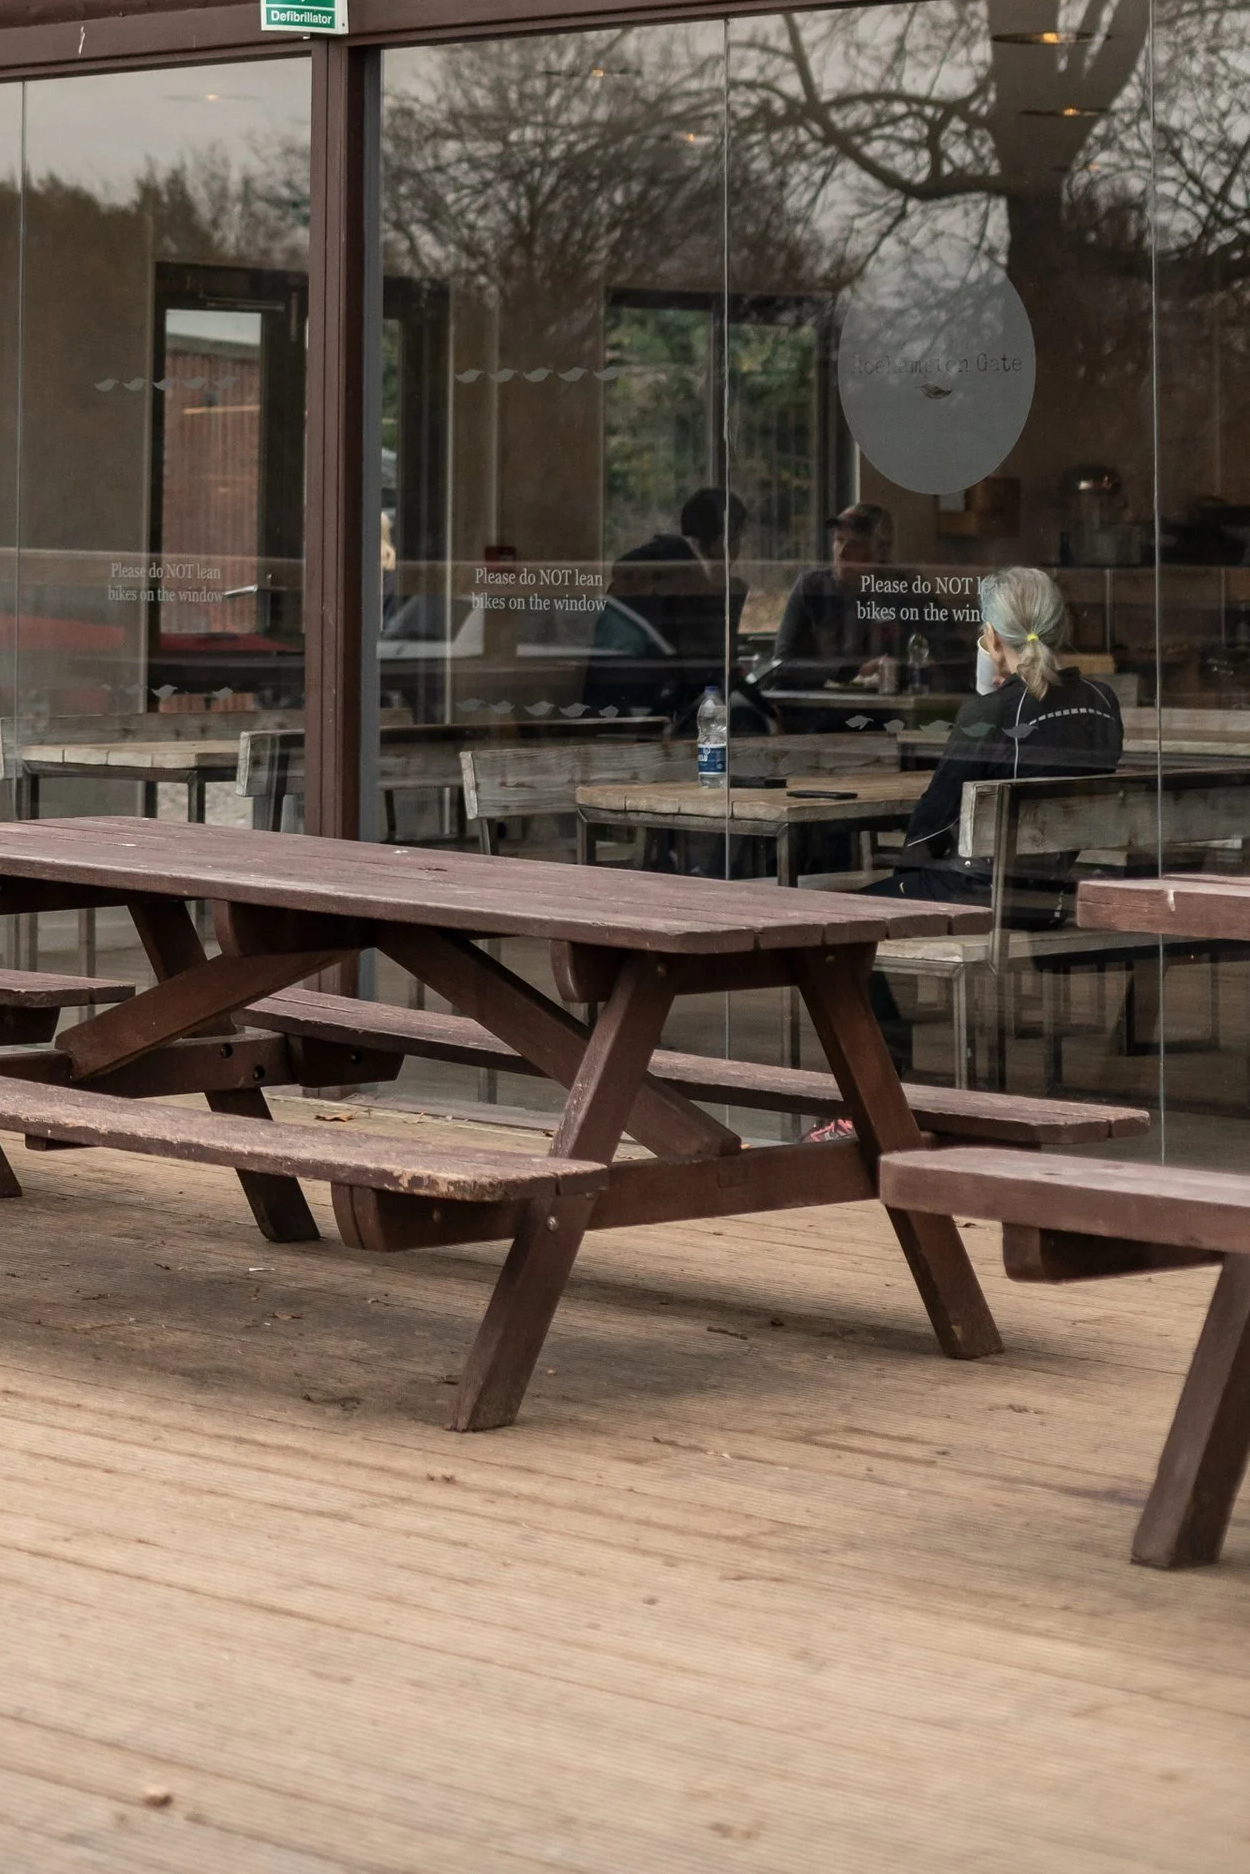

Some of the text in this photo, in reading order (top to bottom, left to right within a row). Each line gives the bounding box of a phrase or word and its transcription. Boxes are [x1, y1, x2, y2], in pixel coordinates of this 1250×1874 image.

[271, 10, 332, 24] Defibrillator
[976, 352, 1023, 373] Gate
[111, 562, 221, 579] Please do NOT lean
[475, 567, 603, 586] Please do NOT lean
[108, 586, 223, 603] bikes on the window
[860, 575, 908, 594] Please
[912, 575, 931, 594] do
[935, 577, 973, 595] NOT
[471, 592, 607, 612] bikes on the window
[856, 601, 896, 620] bikes
[900, 607, 919, 621] on
[924, 602, 948, 621] the
